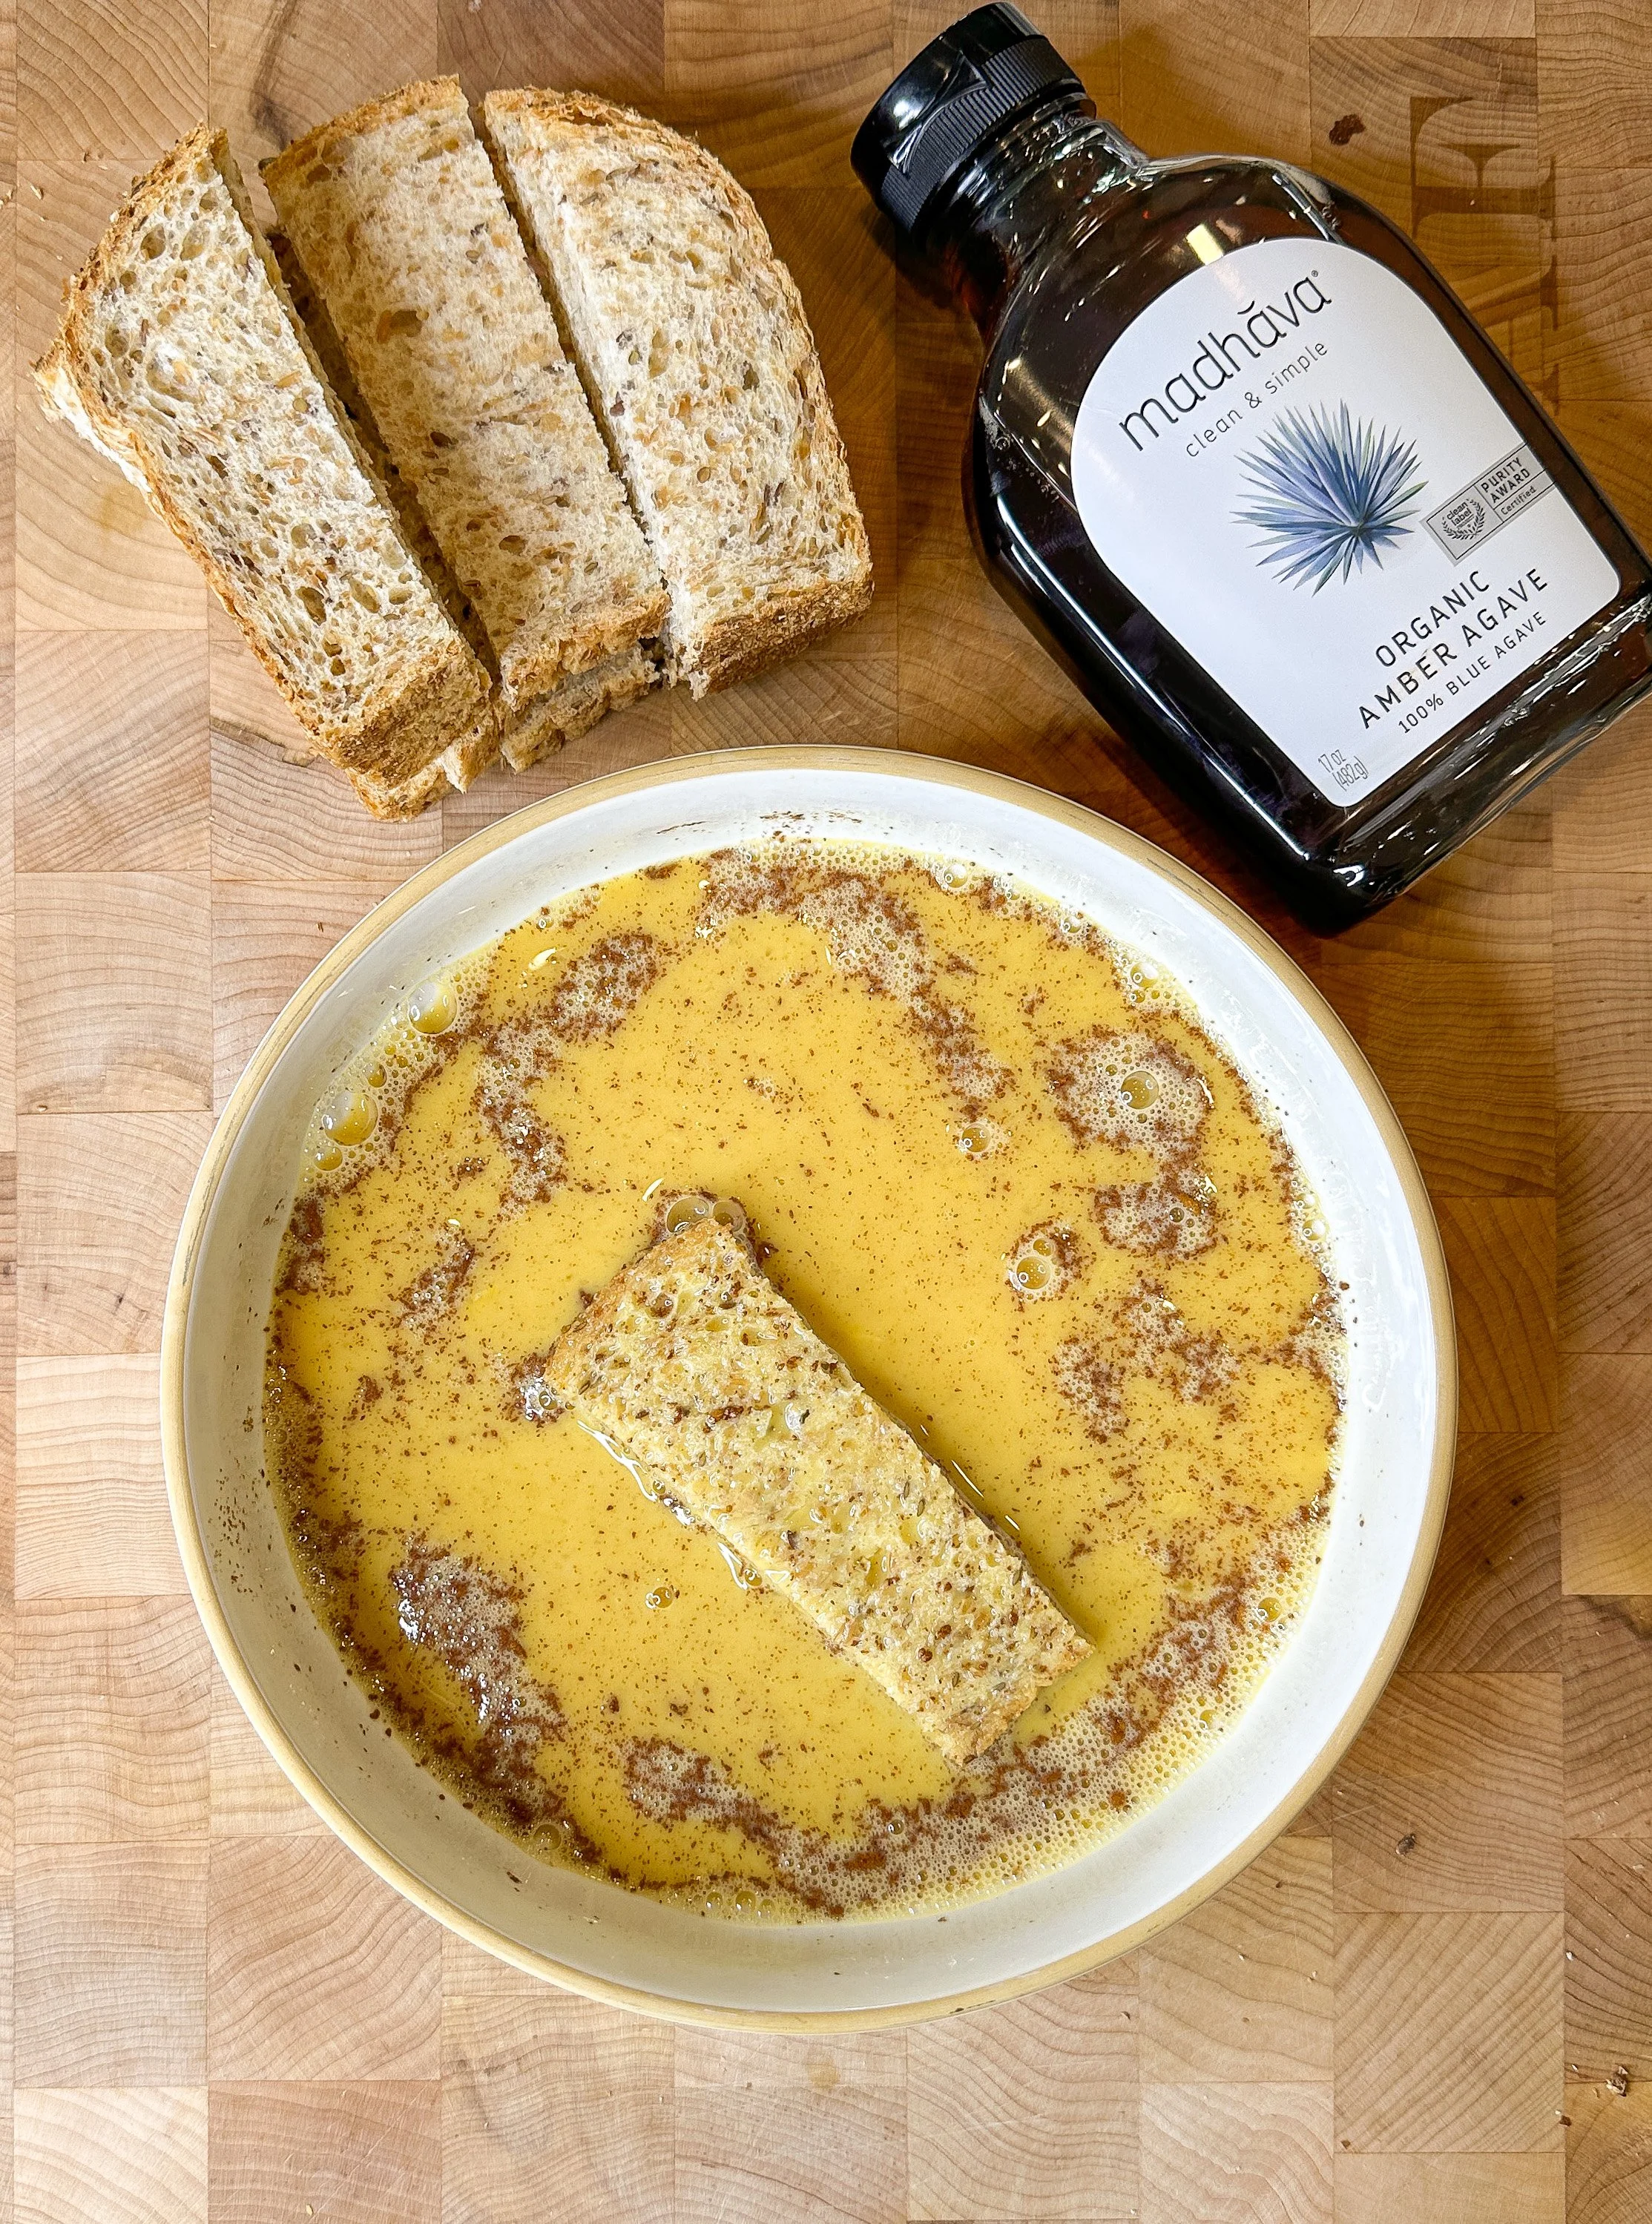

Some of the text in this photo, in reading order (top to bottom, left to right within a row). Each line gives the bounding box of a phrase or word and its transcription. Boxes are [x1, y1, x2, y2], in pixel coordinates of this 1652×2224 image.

[1186, 341, 1328, 457] clean & simple
[1481, 457, 1523, 493] PURITY
[1490, 468, 1530, 503] AWARD
[1447, 501, 1468, 520] clean
[1451, 507, 1472, 526] label
[1501, 485, 1537, 515] Certified
[1375, 570, 1490, 667] ORGANIC
[1358, 568, 1548, 728] AMBER AGAVE
[1398, 611, 1547, 734] 100% BLUE AGAVE
[1332, 755, 1369, 792] (482g)
